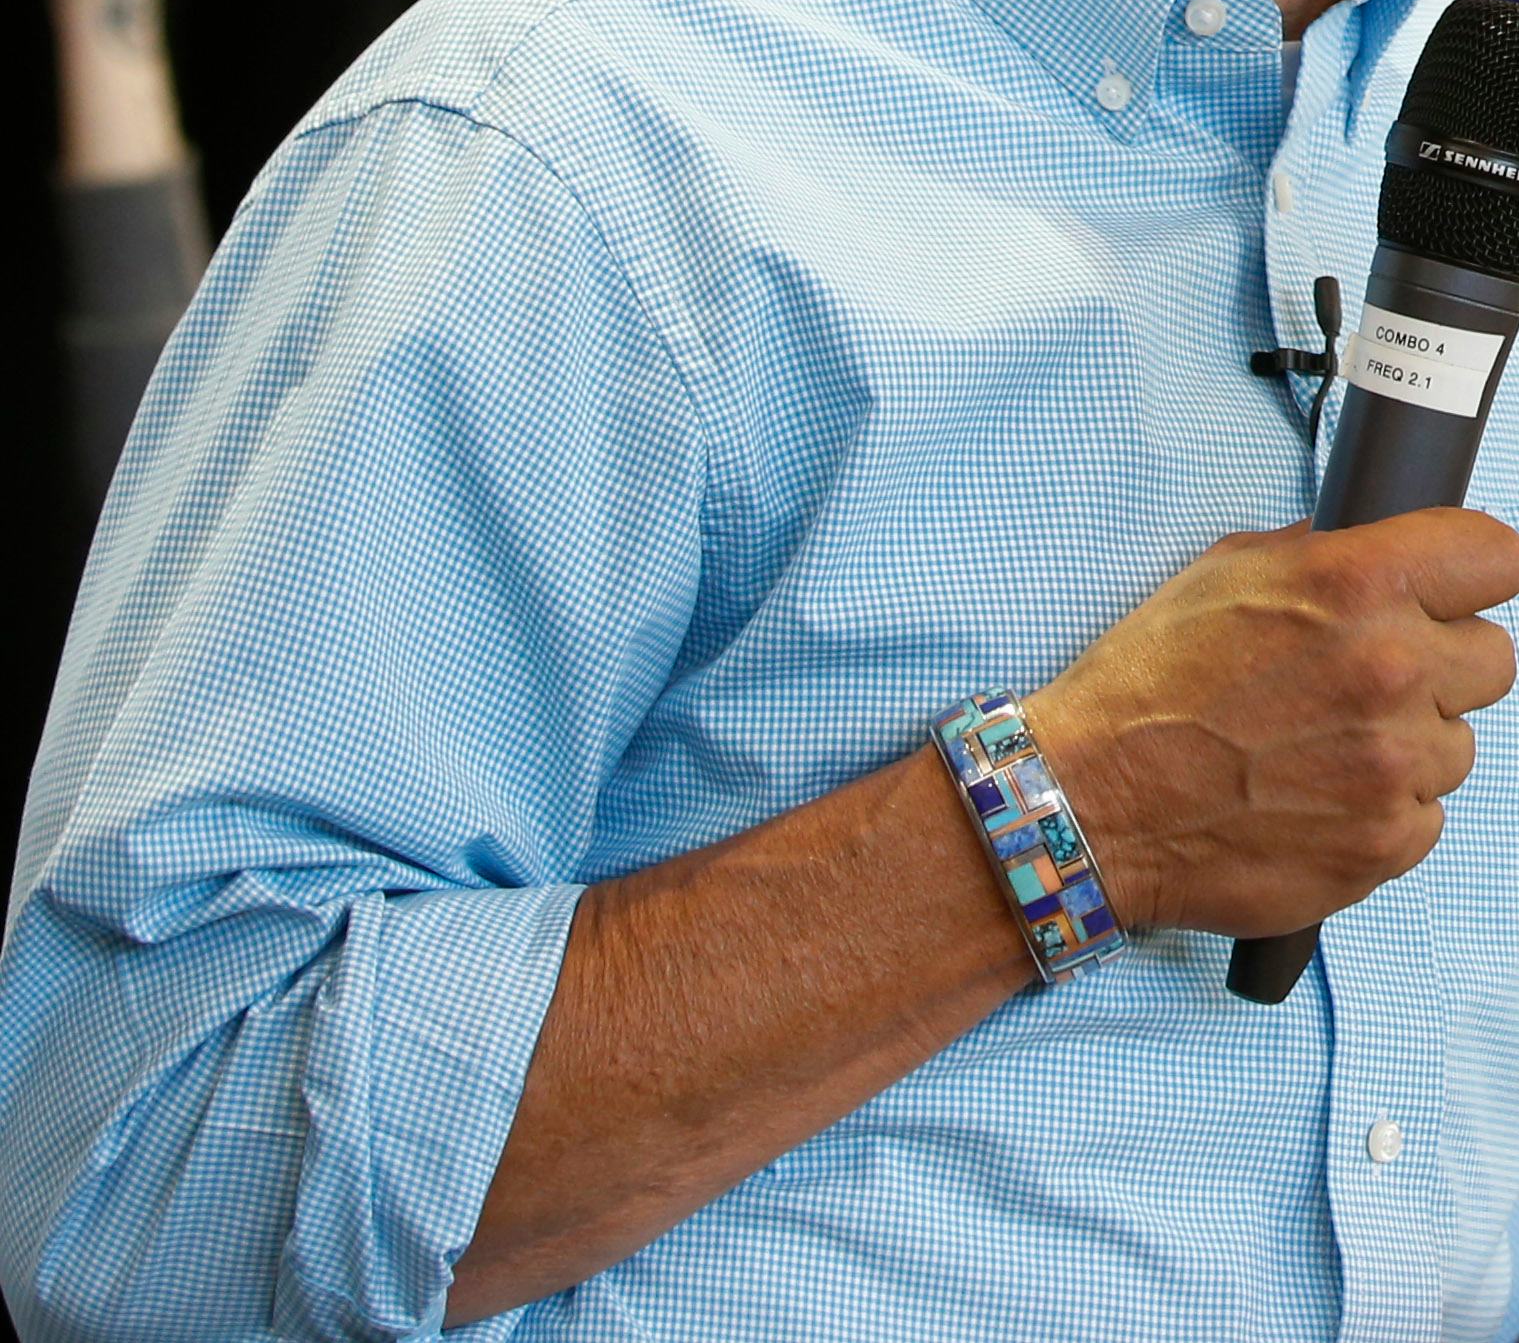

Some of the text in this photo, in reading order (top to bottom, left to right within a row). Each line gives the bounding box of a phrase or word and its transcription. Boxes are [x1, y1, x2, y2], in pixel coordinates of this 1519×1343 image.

[1375, 325, 1445, 356] COMBO 4
[1366, 358, 1432, 390] FREQ 2.1
